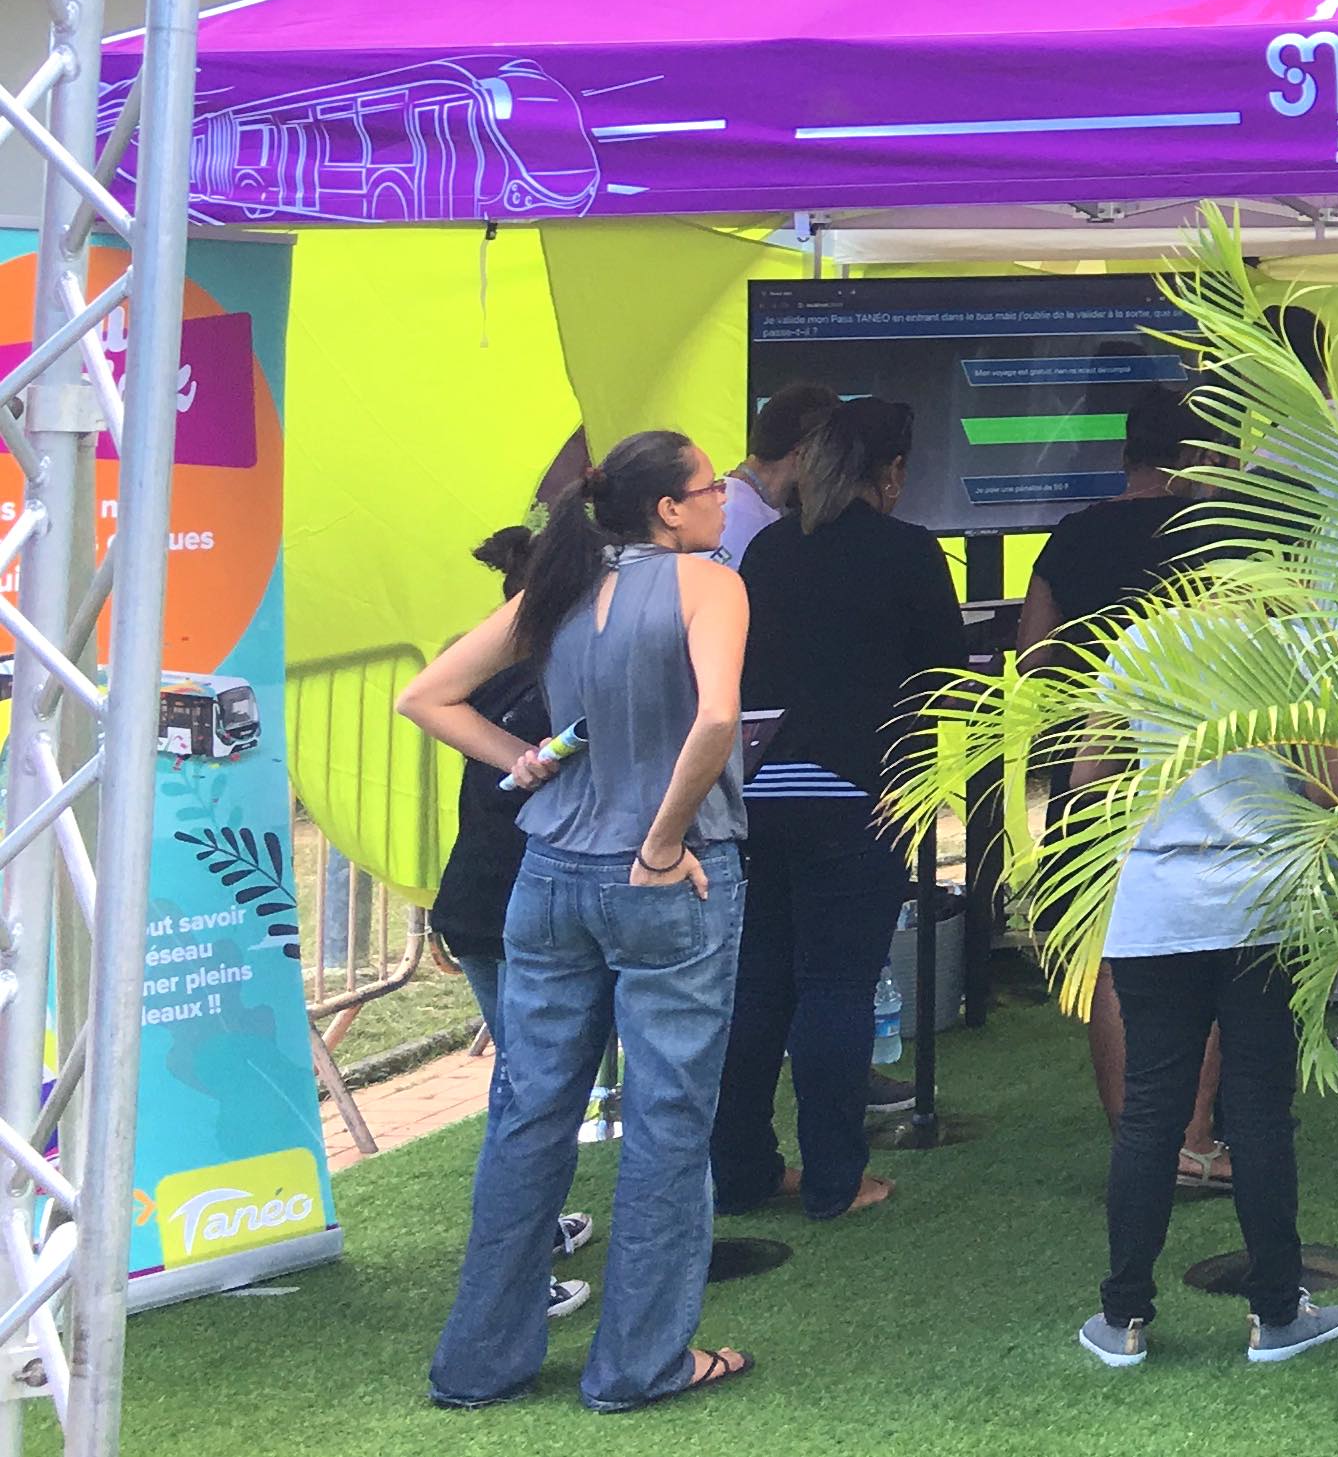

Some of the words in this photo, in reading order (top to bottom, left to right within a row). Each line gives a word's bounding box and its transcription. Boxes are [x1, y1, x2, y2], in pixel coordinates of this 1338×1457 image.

[147, 915, 173, 936] ut
[179, 905, 246, 933] savoir
[145, 944, 213, 966] éseau
[143, 976, 179, 996] ner
[186, 963, 253, 994] pleins
[208, 993, 221, 1014] !!
[169, 1187, 314, 1255] Tanéo
